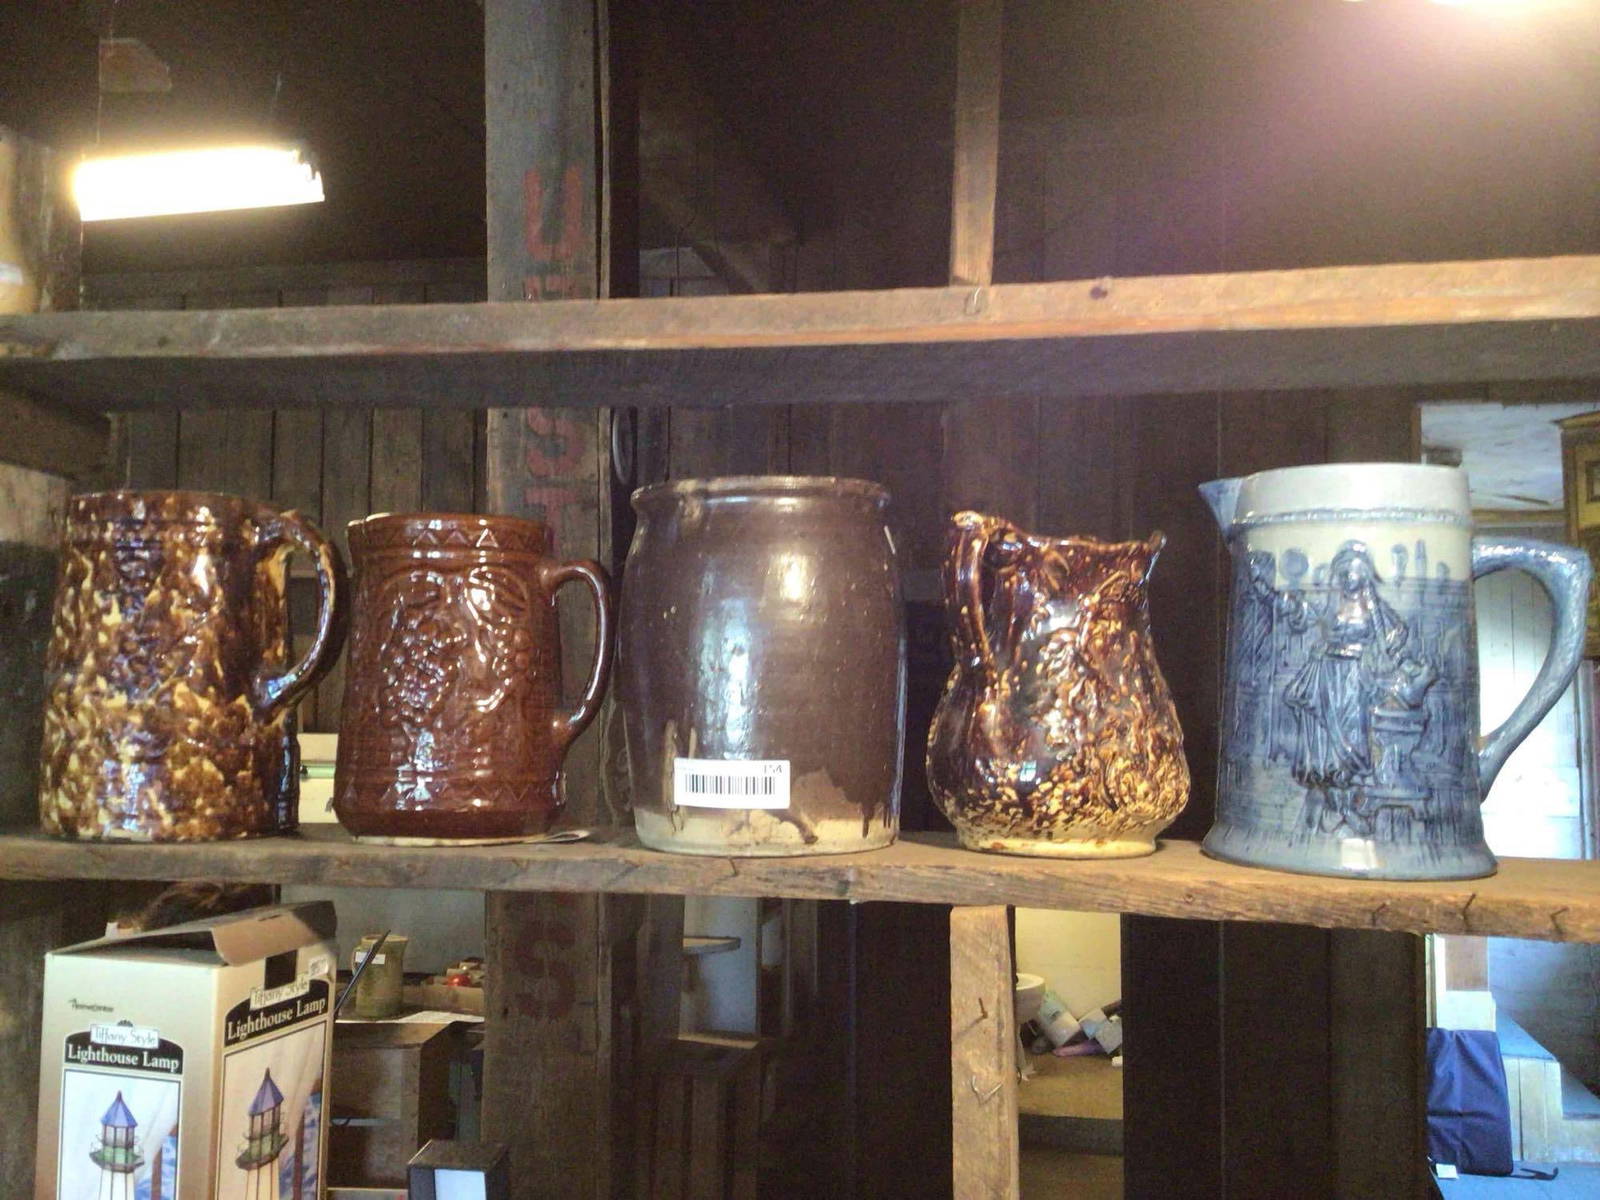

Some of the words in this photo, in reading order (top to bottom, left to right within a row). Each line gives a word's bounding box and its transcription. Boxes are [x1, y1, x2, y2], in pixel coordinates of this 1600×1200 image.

[228, 1007, 293, 1040] Lighthouse
[296, 998, 326, 1017] Lamp
[95, 1026, 127, 1045] Tiffany
[68, 1044, 138, 1064] Lighthouse
[142, 1051, 179, 1073] Lamp
